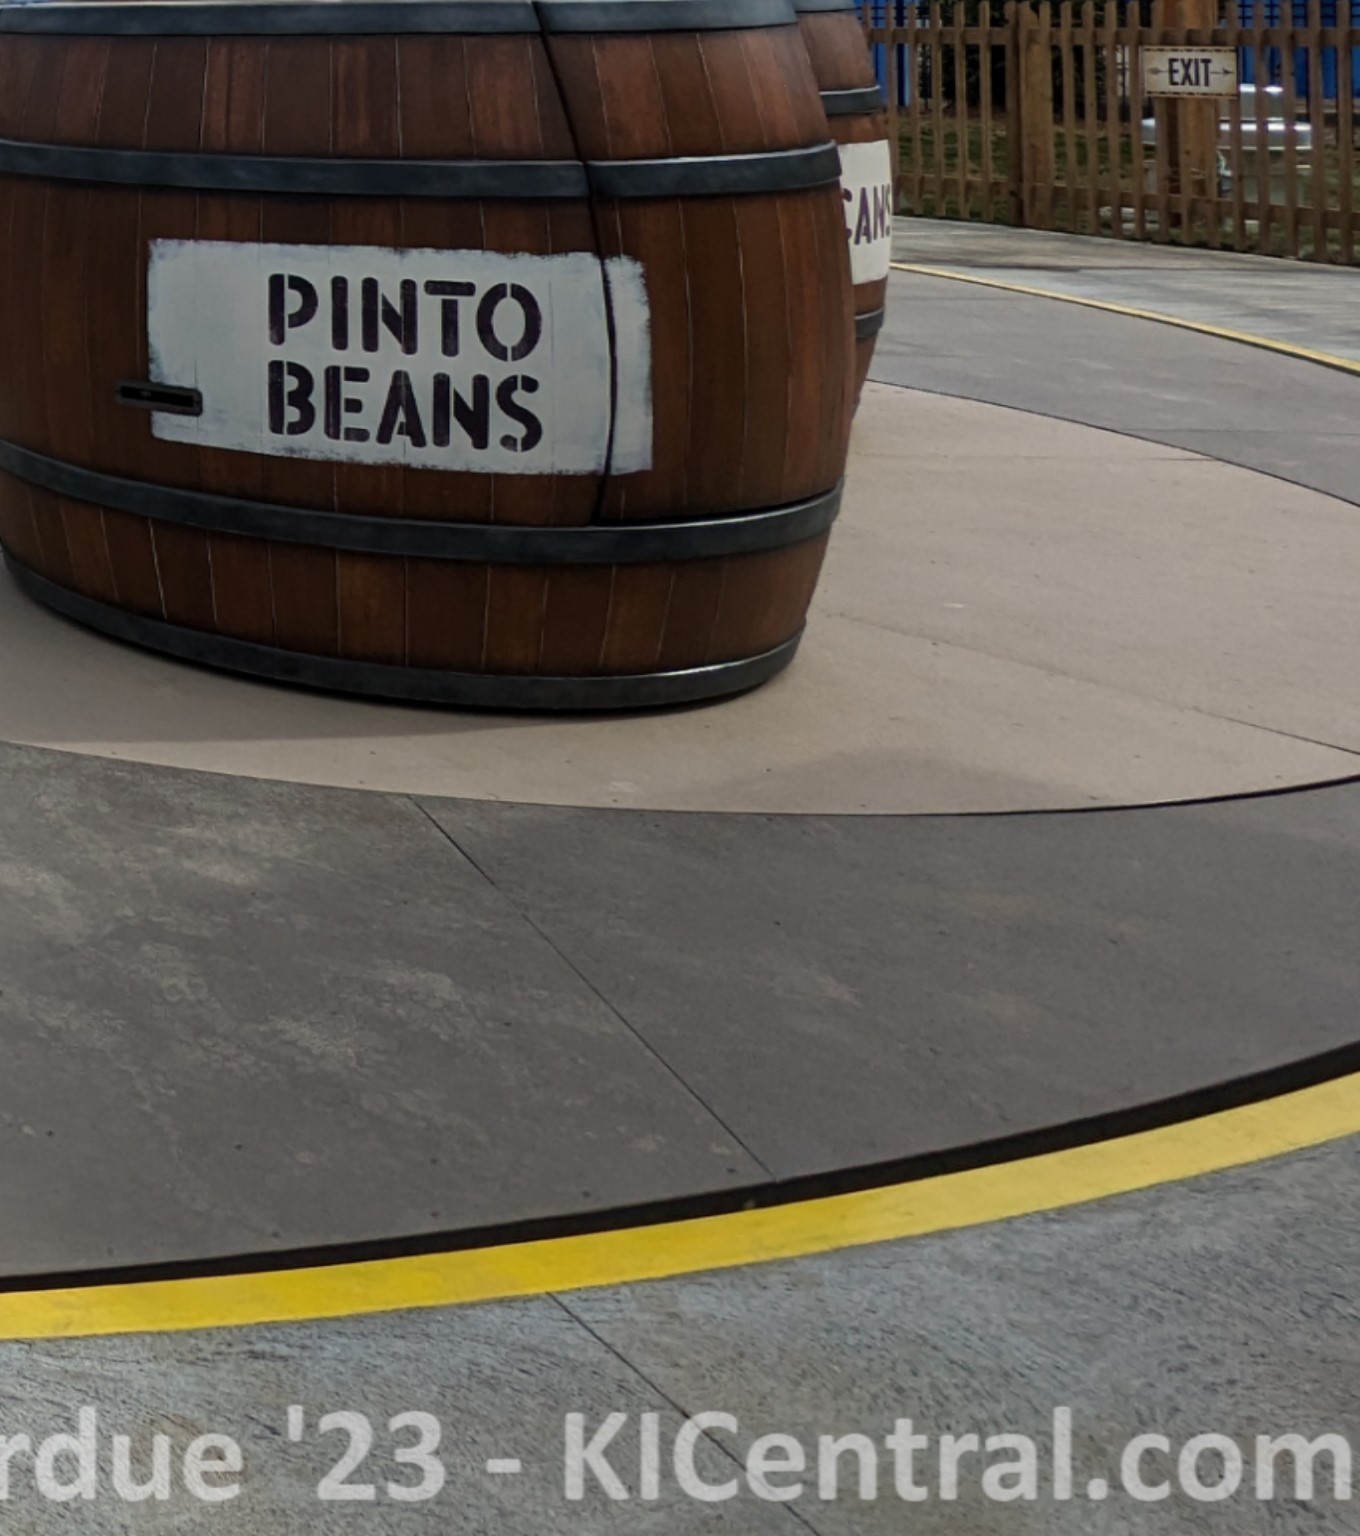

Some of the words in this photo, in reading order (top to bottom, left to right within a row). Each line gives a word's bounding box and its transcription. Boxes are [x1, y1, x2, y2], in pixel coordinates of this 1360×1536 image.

[1168, 58, 1212, 87] EXIT
[268, 273, 542, 362] PINTO
[268, 360, 543, 453] BEANS
